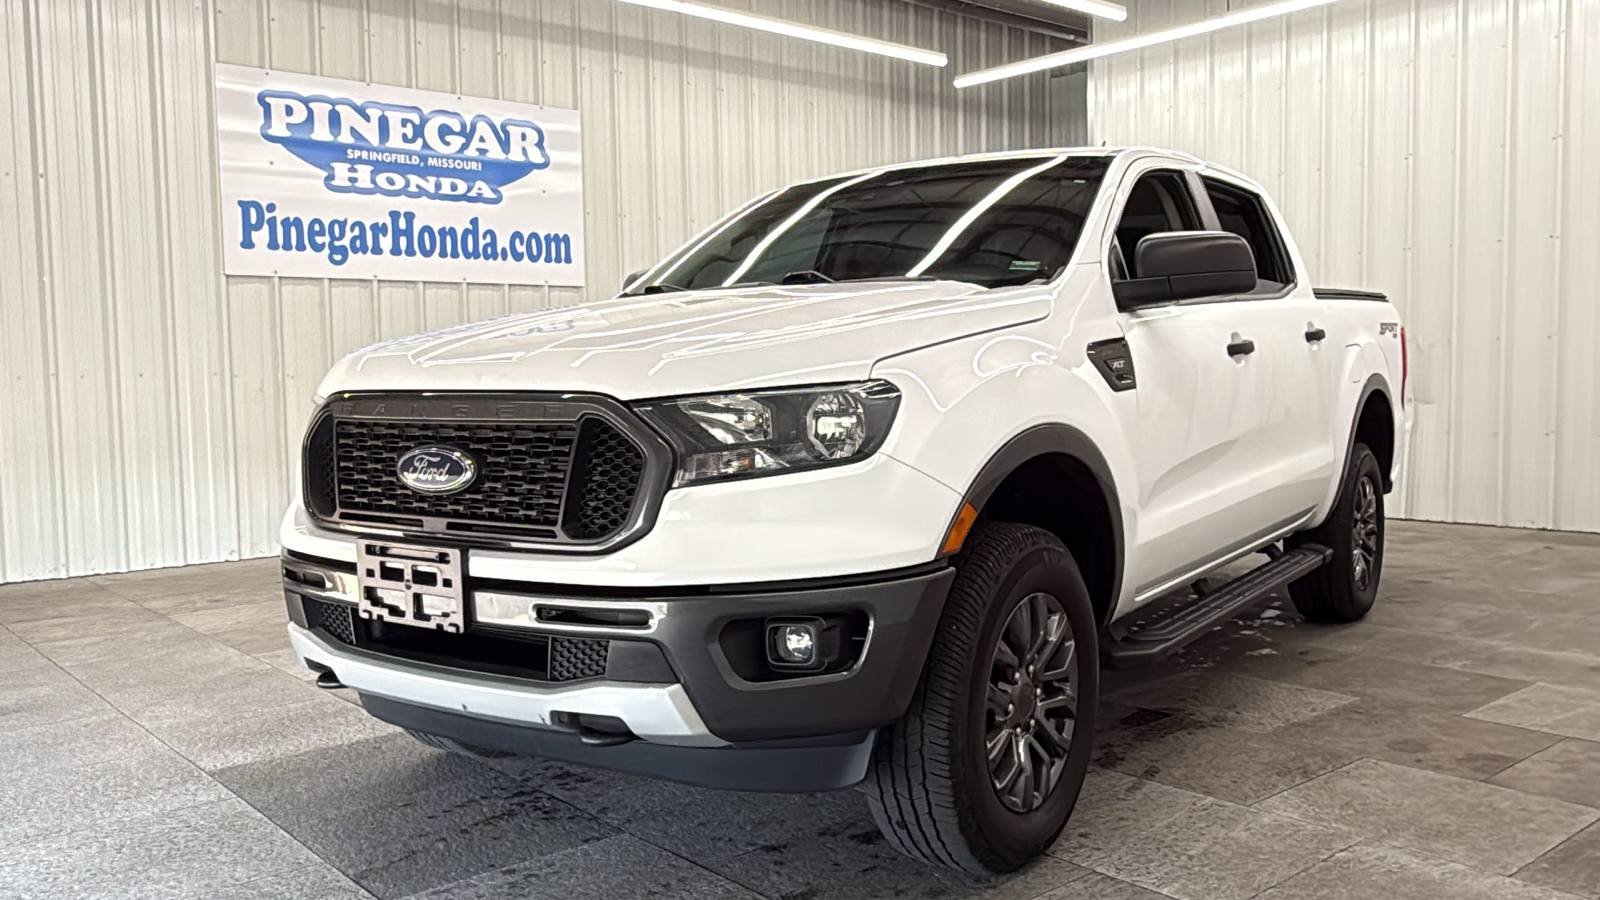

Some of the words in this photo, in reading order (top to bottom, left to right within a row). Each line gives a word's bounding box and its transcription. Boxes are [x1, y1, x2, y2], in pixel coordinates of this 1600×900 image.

[264, 97, 546, 164] PINEGAR
[346, 148, 425, 168] SPRINGFIELD,
[427, 157, 483, 172] MISSOURI
[329, 162, 498, 199] HONDA
[237, 200, 573, 266] PinegarHonda.com
[408, 454, 451, 482] Ford
